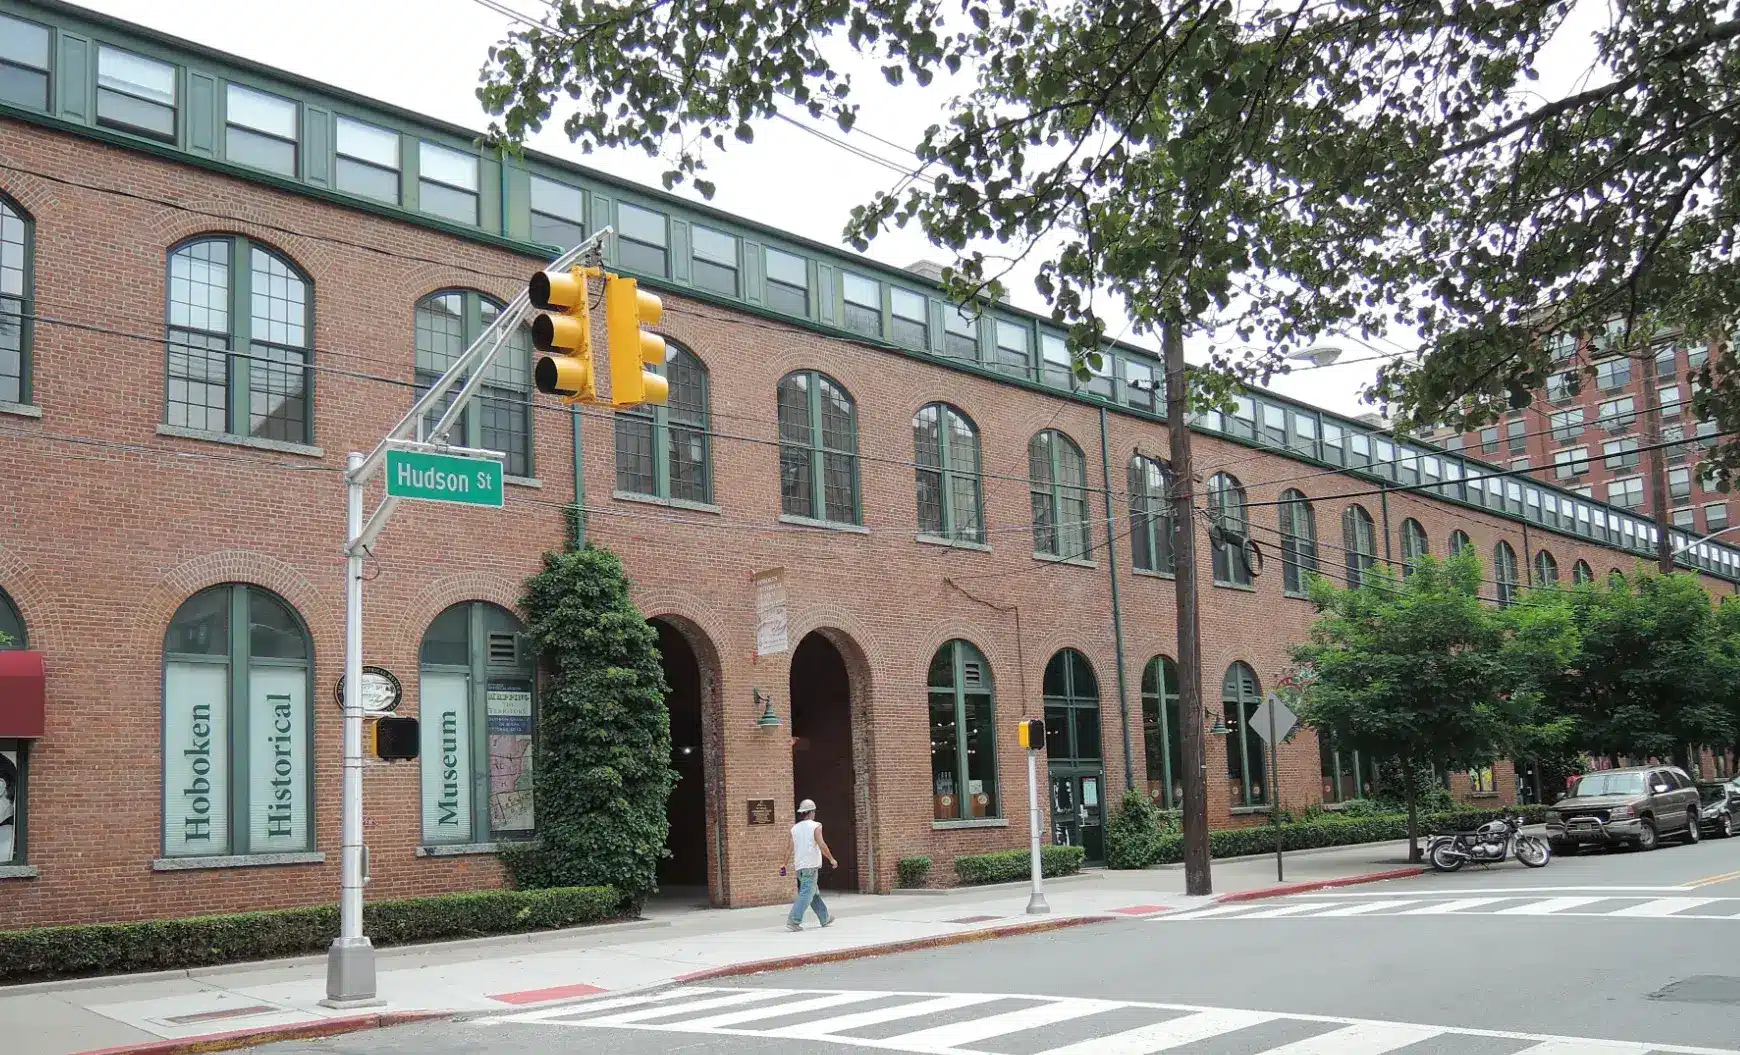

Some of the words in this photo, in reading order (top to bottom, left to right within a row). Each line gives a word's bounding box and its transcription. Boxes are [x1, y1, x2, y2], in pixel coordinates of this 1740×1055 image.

[397, 462, 469, 493] Hudson
[476, 471, 493, 490] St
[184, 704, 211, 843] Hoboken
[266, 693, 292, 838] Historical
[438, 710, 459, 828] Museum
